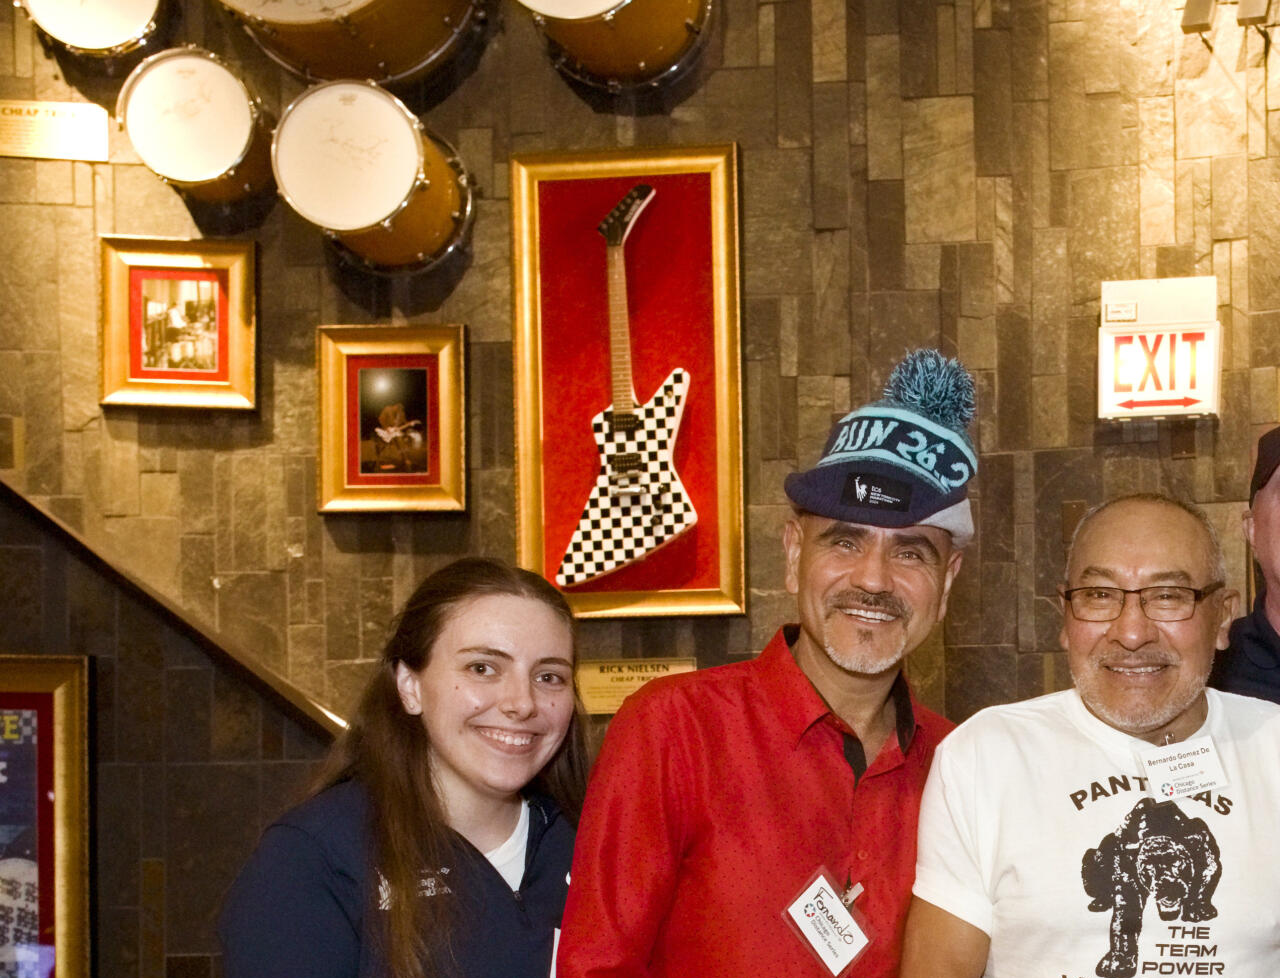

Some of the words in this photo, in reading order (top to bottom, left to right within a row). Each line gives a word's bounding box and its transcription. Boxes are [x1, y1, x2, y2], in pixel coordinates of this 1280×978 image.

[1113, 331, 1206, 393] EXIT
[828, 419, 900, 454] RUN
[599, 664, 624, 673] RICK
[627, 663, 670, 673] NIELSEN
[1147, 754, 1178, 767] Bernardo
[1177, 749, 1200, 760] Gomez
[1200, 746, 1210, 754] De
[1169, 764, 1178, 772] La
[1069, 774, 1234, 816] PANTAS
[1167, 925, 1211, 940] THE
[1155, 943, 1218, 957] TEAM
[1141, 961, 1226, 976] POWER
